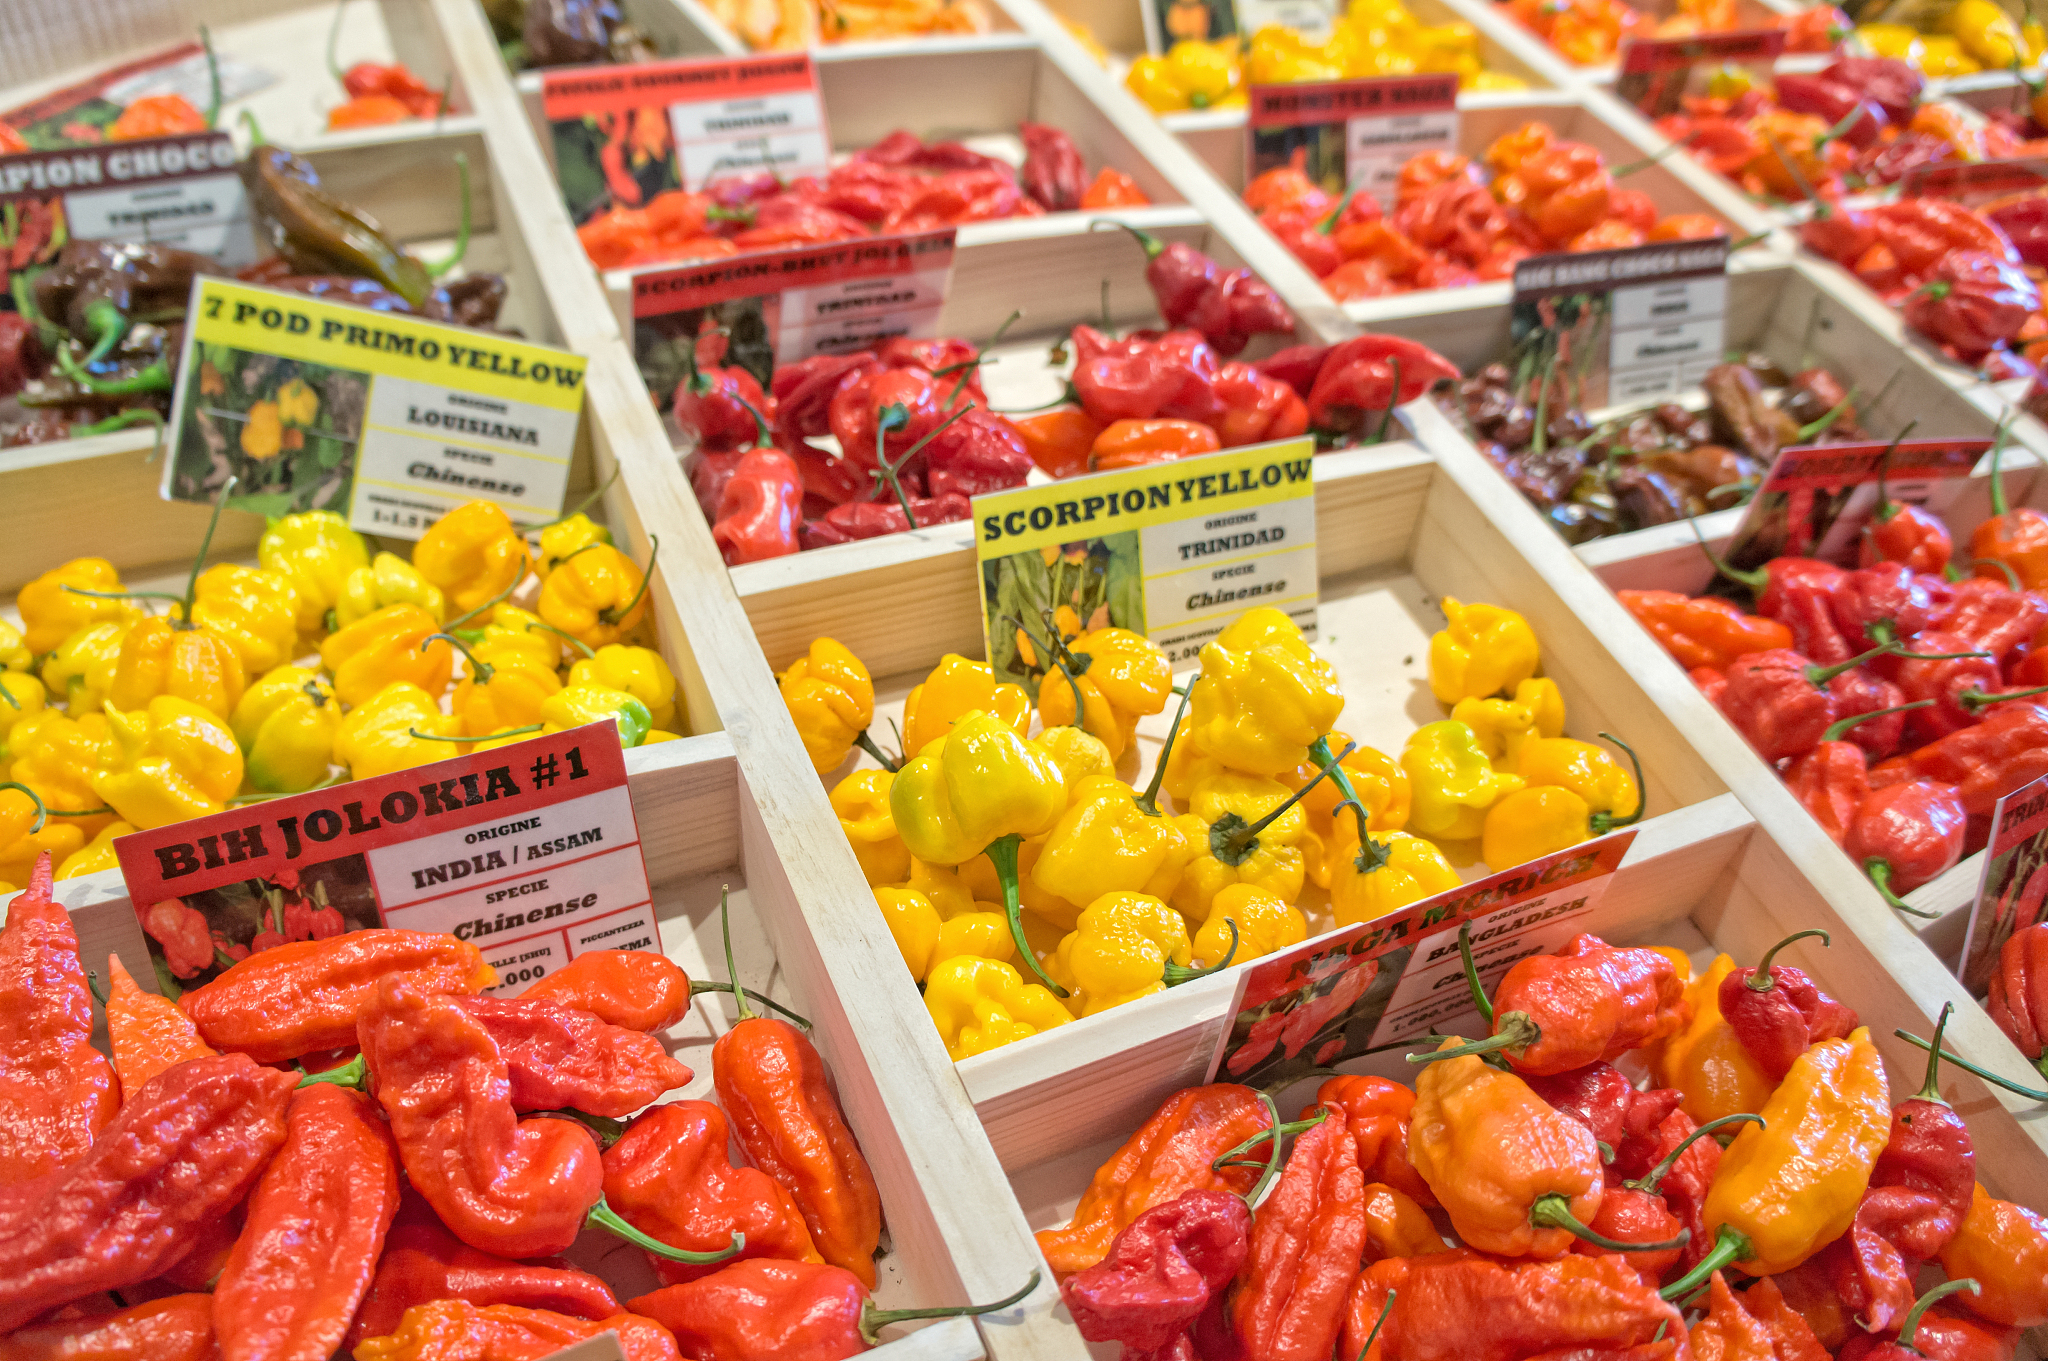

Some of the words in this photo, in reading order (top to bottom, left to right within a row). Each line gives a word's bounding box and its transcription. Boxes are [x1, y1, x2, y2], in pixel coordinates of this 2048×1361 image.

[108, 139, 236, 181] CHOCO
[205, 294, 225, 319] 7
[233, 301, 311, 336] POD
[319, 318, 441, 362] PRIMO
[447, 343, 583, 391] YELLOW
[407, 405, 539, 446] LOUISIANA
[406, 461, 526, 497] Chinense
[982, 480, 1171, 542] SCORPION
[1174, 458, 1313, 504] YELLOW
[1204, 511, 1258, 530] ORIGINE
[1178, 526, 1287, 561] TRINIDAD
[1212, 563, 1256, 581] SPECIE
[1185, 578, 1288, 611] Chinense
[1168, 642, 1208, 662] 2.00
[154, 823, 269, 881] BIH
[277, 758, 521, 860] JOLOKIA
[529, 746, 590, 791] #1
[2001, 788, 2048, 835] TRIN
[464, 816, 542, 845] ORIGINE
[411, 848, 503, 890] INDIA
[512, 844, 520, 865] /
[526, 826, 604, 863] ASSAM
[485, 878, 550, 905] SPECIE
[453, 892, 599, 942] Chinense
[1488, 897, 1547, 924] ORIGINE
[580, 919, 645, 945] PICCANTEZZA
[1284, 917, 1412, 984] NAGA
[486, 965, 545, 991] .000
